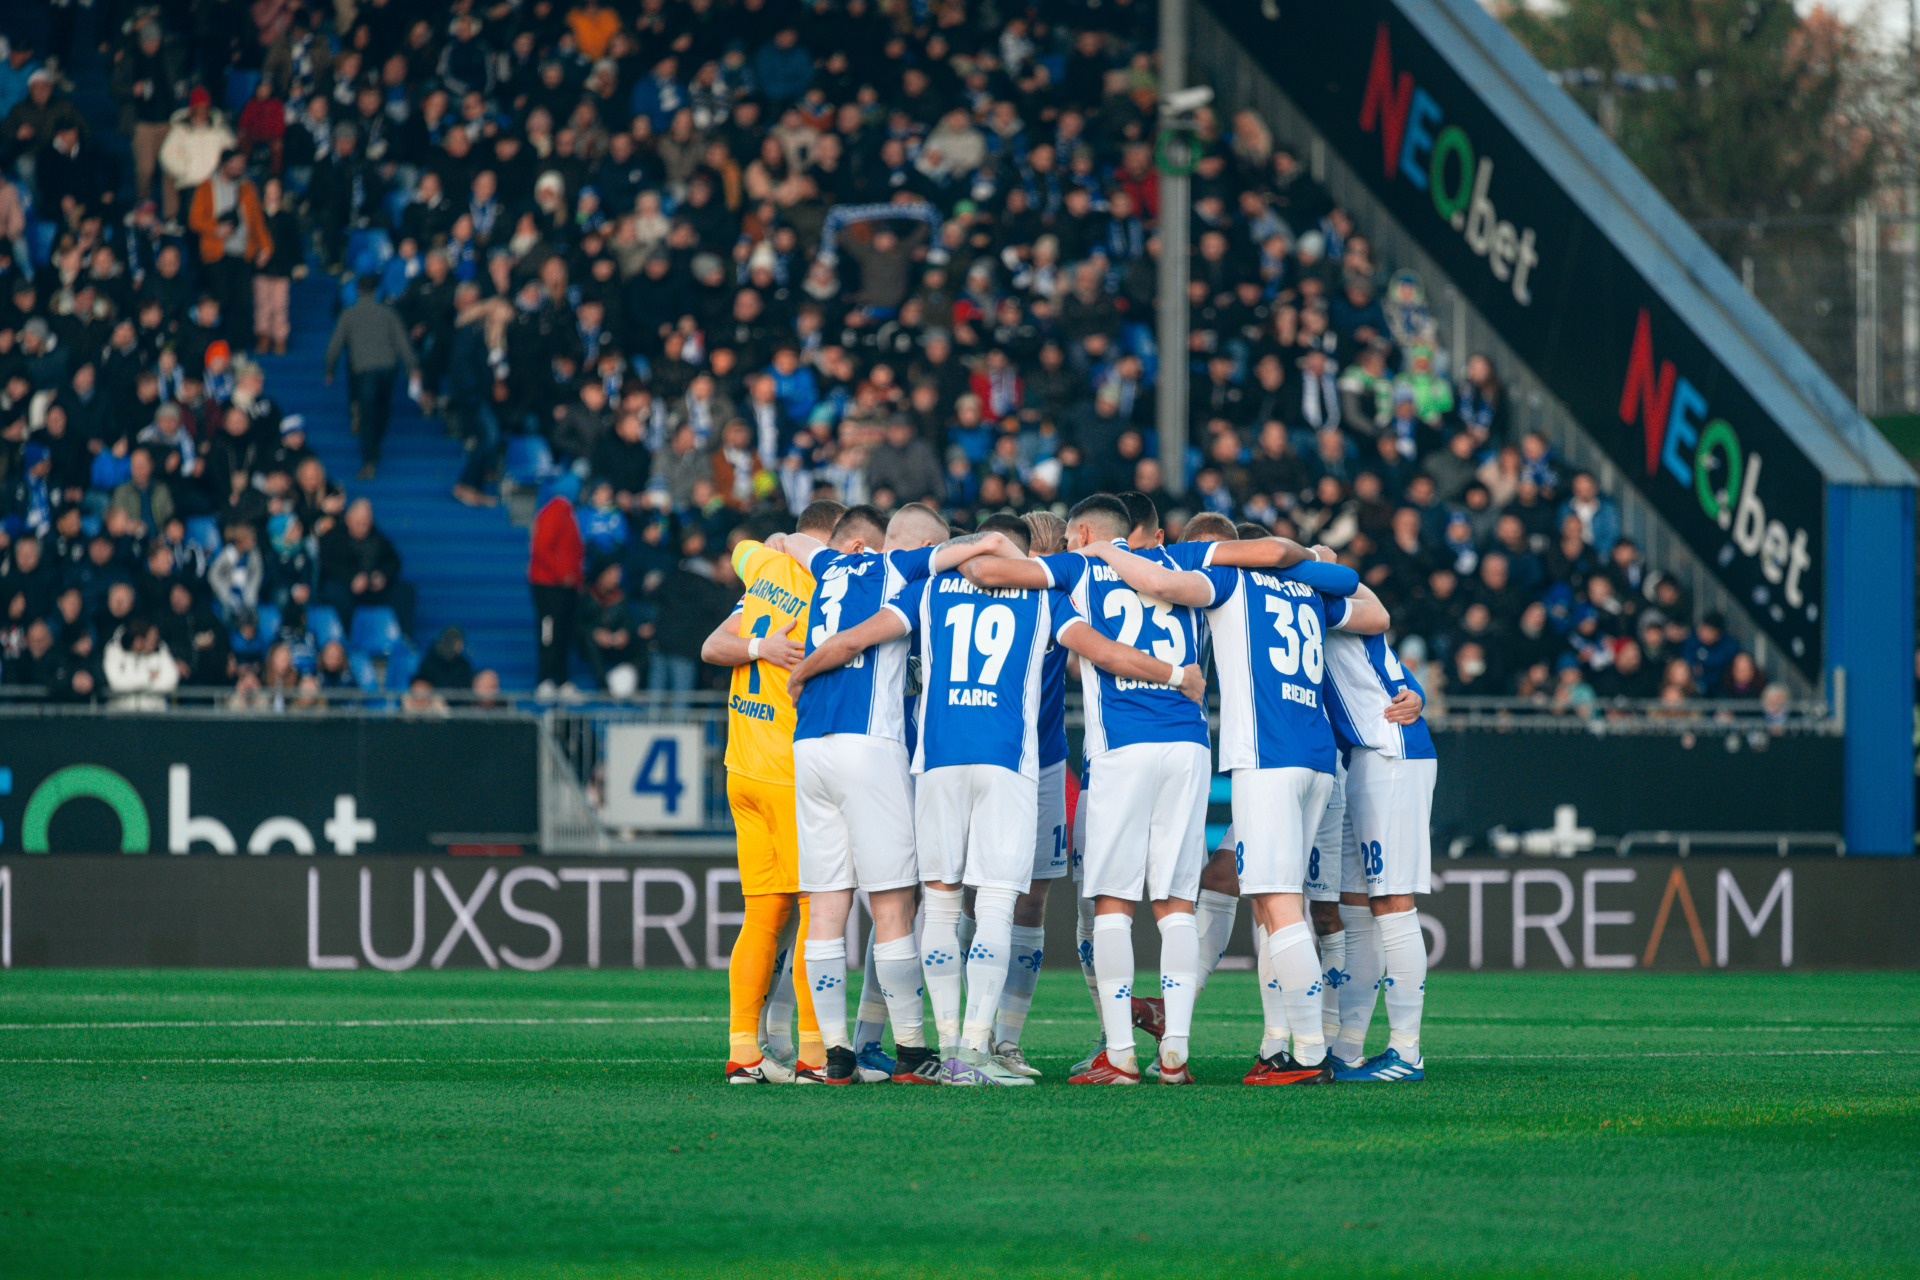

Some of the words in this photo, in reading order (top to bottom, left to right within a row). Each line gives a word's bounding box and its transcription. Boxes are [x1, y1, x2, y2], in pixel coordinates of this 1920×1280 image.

[747, 577, 808, 618] DARMSTADT
[811, 572, 848, 653] 3
[1103, 588, 1186, 666] 23
[748, 614, 771, 694] 1
[945, 603, 1016, 685] 19
[1265, 594, 1324, 685] 38
[948, 689, 997, 707] KARIC
[1282, 682, 1317, 708] RIEDEL
[633, 737, 685, 814] 4
[1361, 840, 1383, 876] 28
